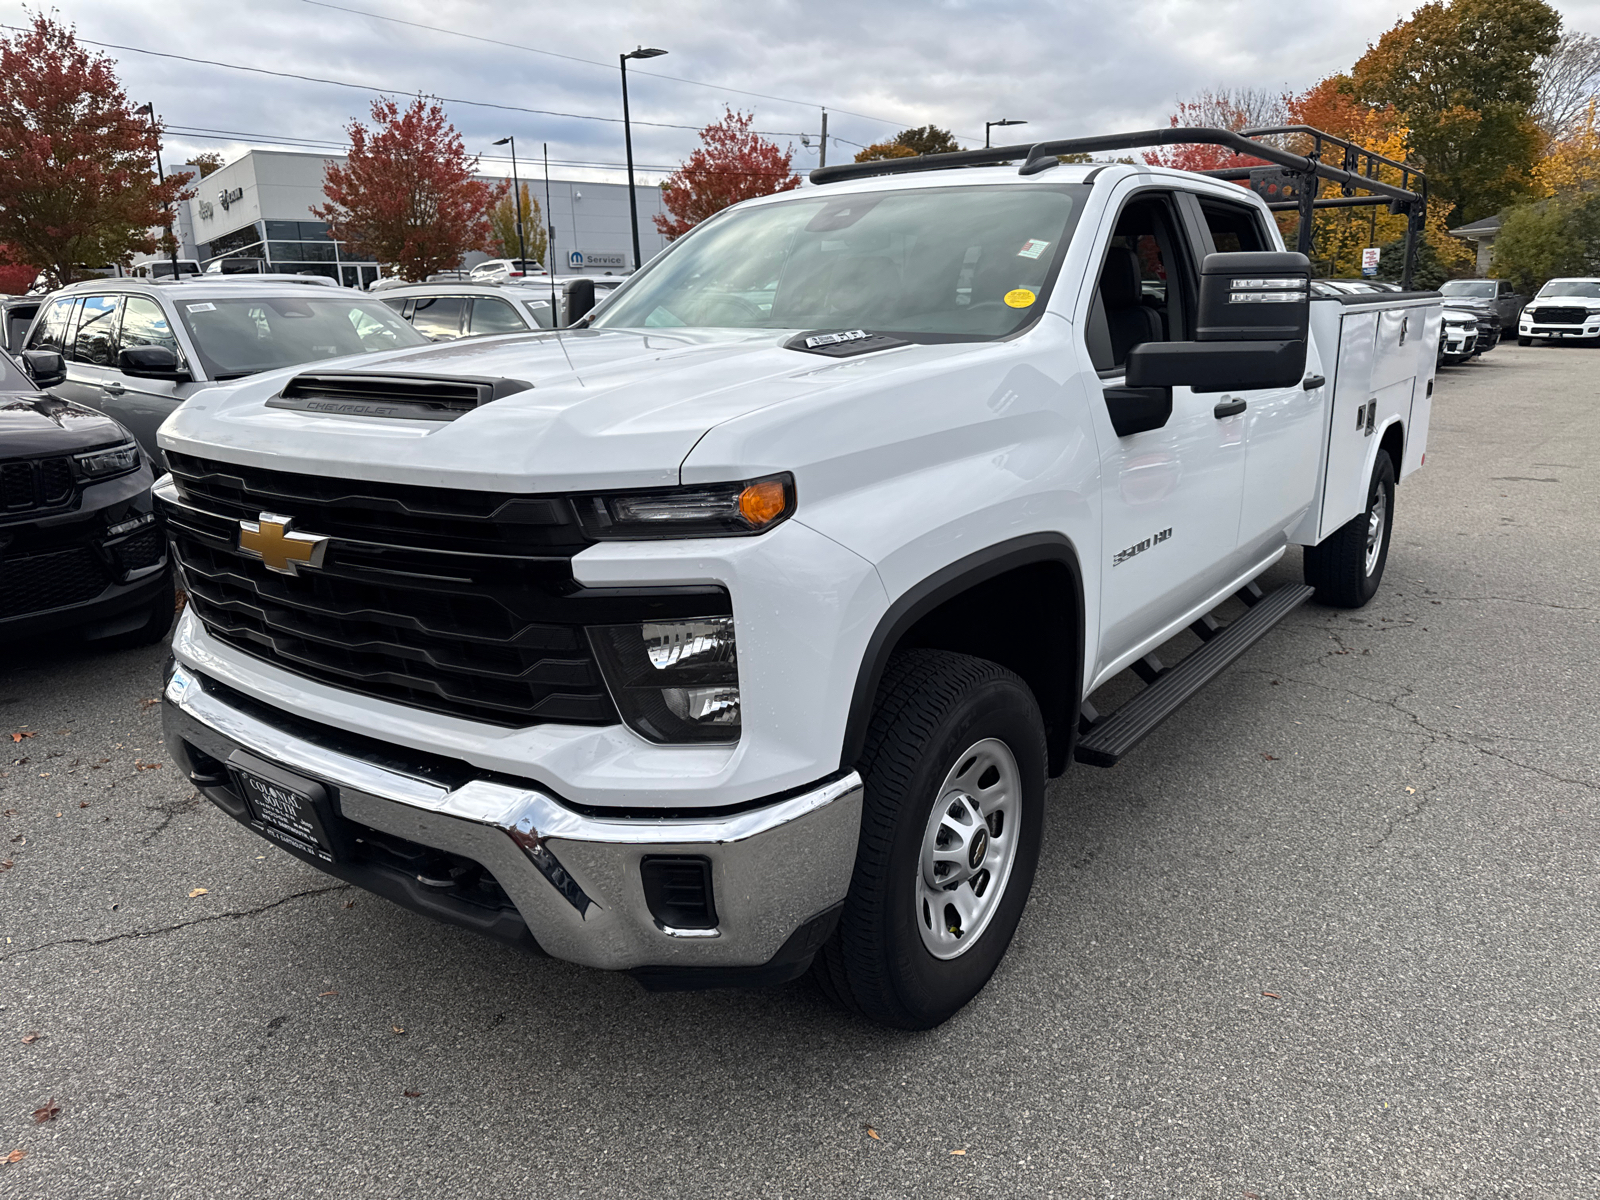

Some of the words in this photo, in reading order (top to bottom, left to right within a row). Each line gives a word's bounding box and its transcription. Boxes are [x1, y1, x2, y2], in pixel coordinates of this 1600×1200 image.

[587, 255, 622, 264] Service
[306, 401, 399, 415] CHEVROLET
[1153, 527, 1173, 546] HD
[249, 778, 301, 810] COLONIAL
[254, 799, 296, 821] CHRYSLER
[262, 793, 297, 817] SOUTH
